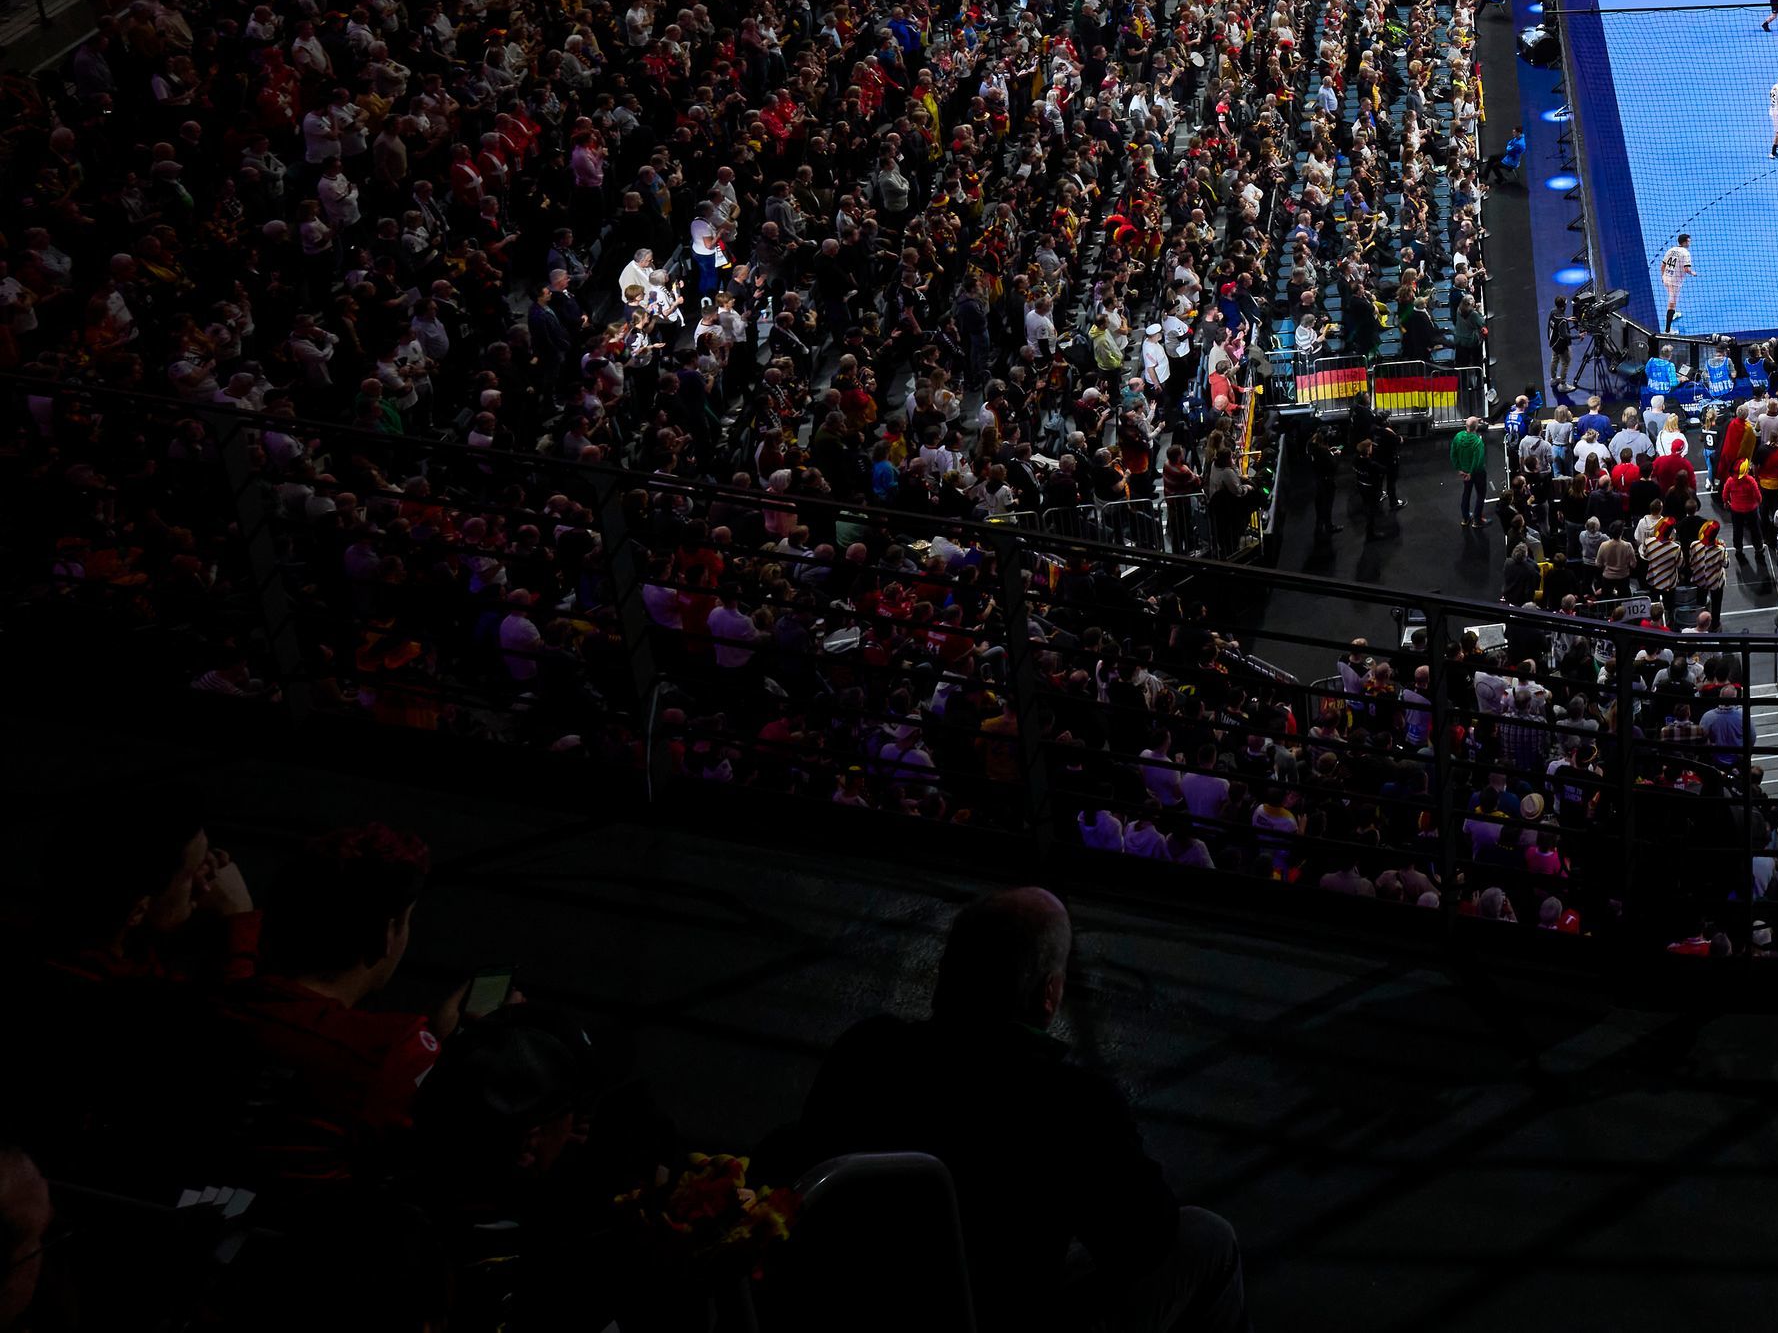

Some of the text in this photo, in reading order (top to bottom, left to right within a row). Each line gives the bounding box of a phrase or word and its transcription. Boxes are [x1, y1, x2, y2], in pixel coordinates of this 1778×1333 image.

[1667, 257, 1677, 269] 44
[1706, 435, 1713, 447] 9
[1627, 604, 1646, 615] 102
